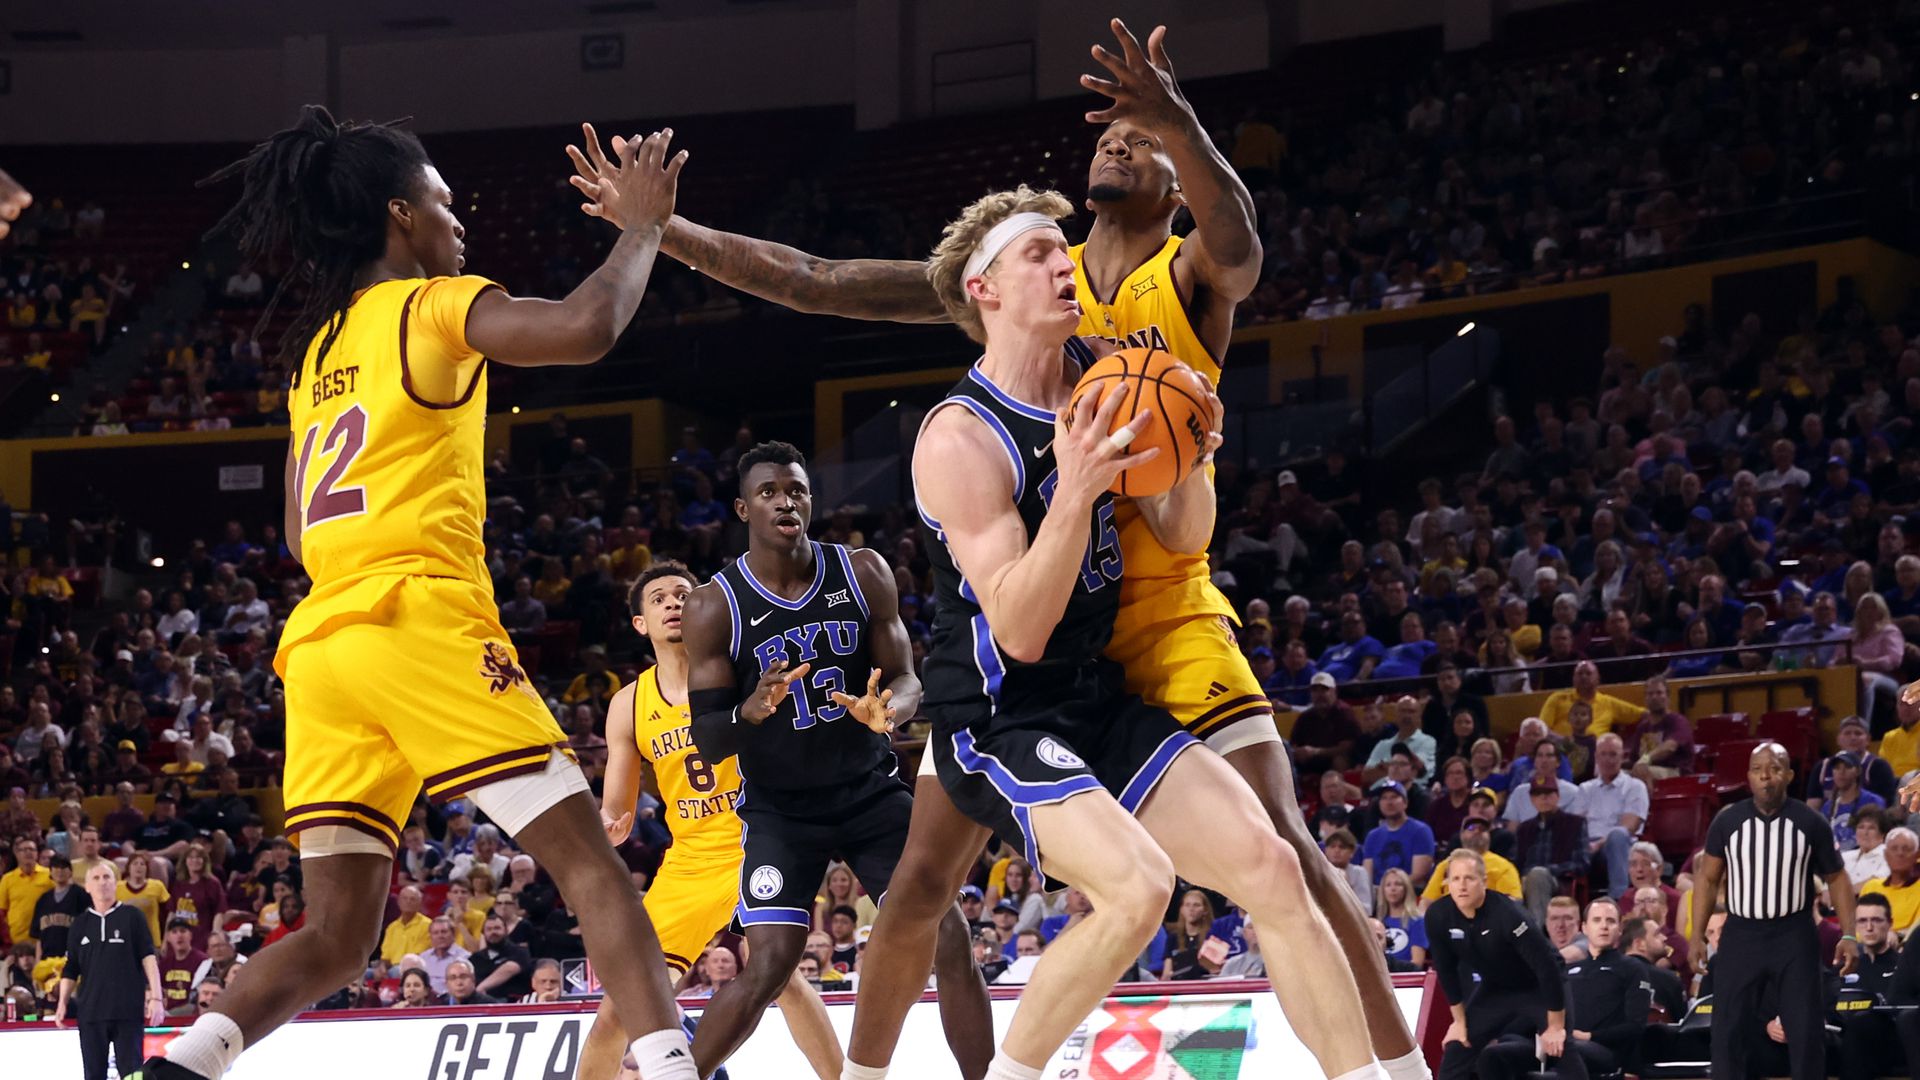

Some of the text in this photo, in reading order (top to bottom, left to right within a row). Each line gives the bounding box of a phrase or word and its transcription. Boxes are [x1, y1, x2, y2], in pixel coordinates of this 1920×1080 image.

[312, 365, 359, 408] BEST
[294, 404, 368, 531] 12
[753, 620, 859, 679] BYU
[787, 665, 848, 731] 13
[684, 752, 717, 793] 8
[677, 789, 739, 819] STATE
[427, 1021, 539, 1080] GET
